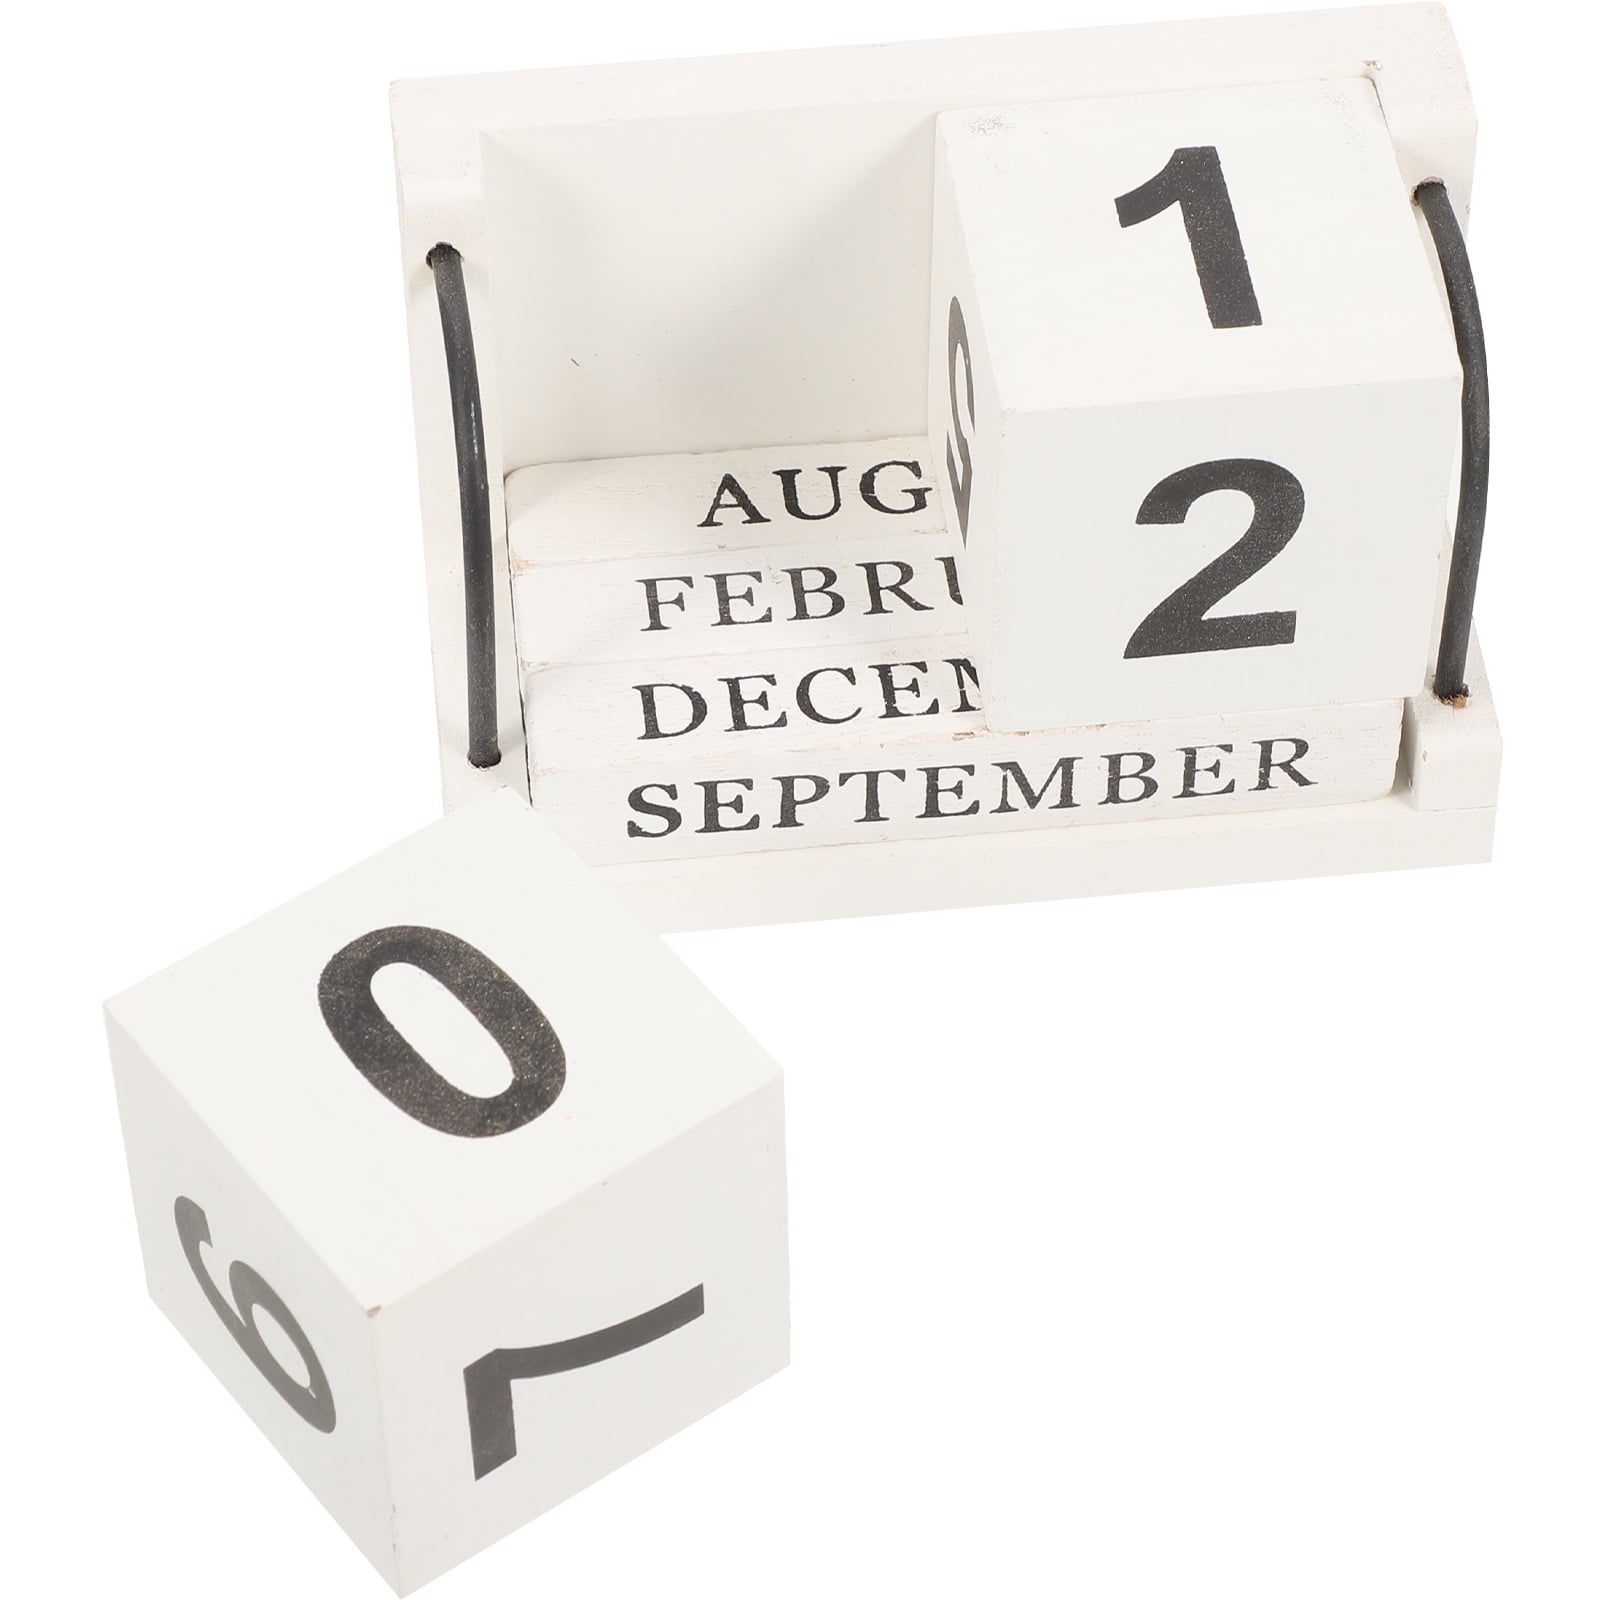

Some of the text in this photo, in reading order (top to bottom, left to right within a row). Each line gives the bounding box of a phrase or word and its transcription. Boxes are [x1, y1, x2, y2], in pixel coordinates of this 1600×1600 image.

[1115, 147, 1262, 328] 1
[697, 461, 933, 527] AUG
[1124, 459, 1305, 660] 2
[627, 738, 1318, 837] SEPTEMBER
[318, 926, 566, 1138] 0
[463, 1283, 705, 1481] 7
